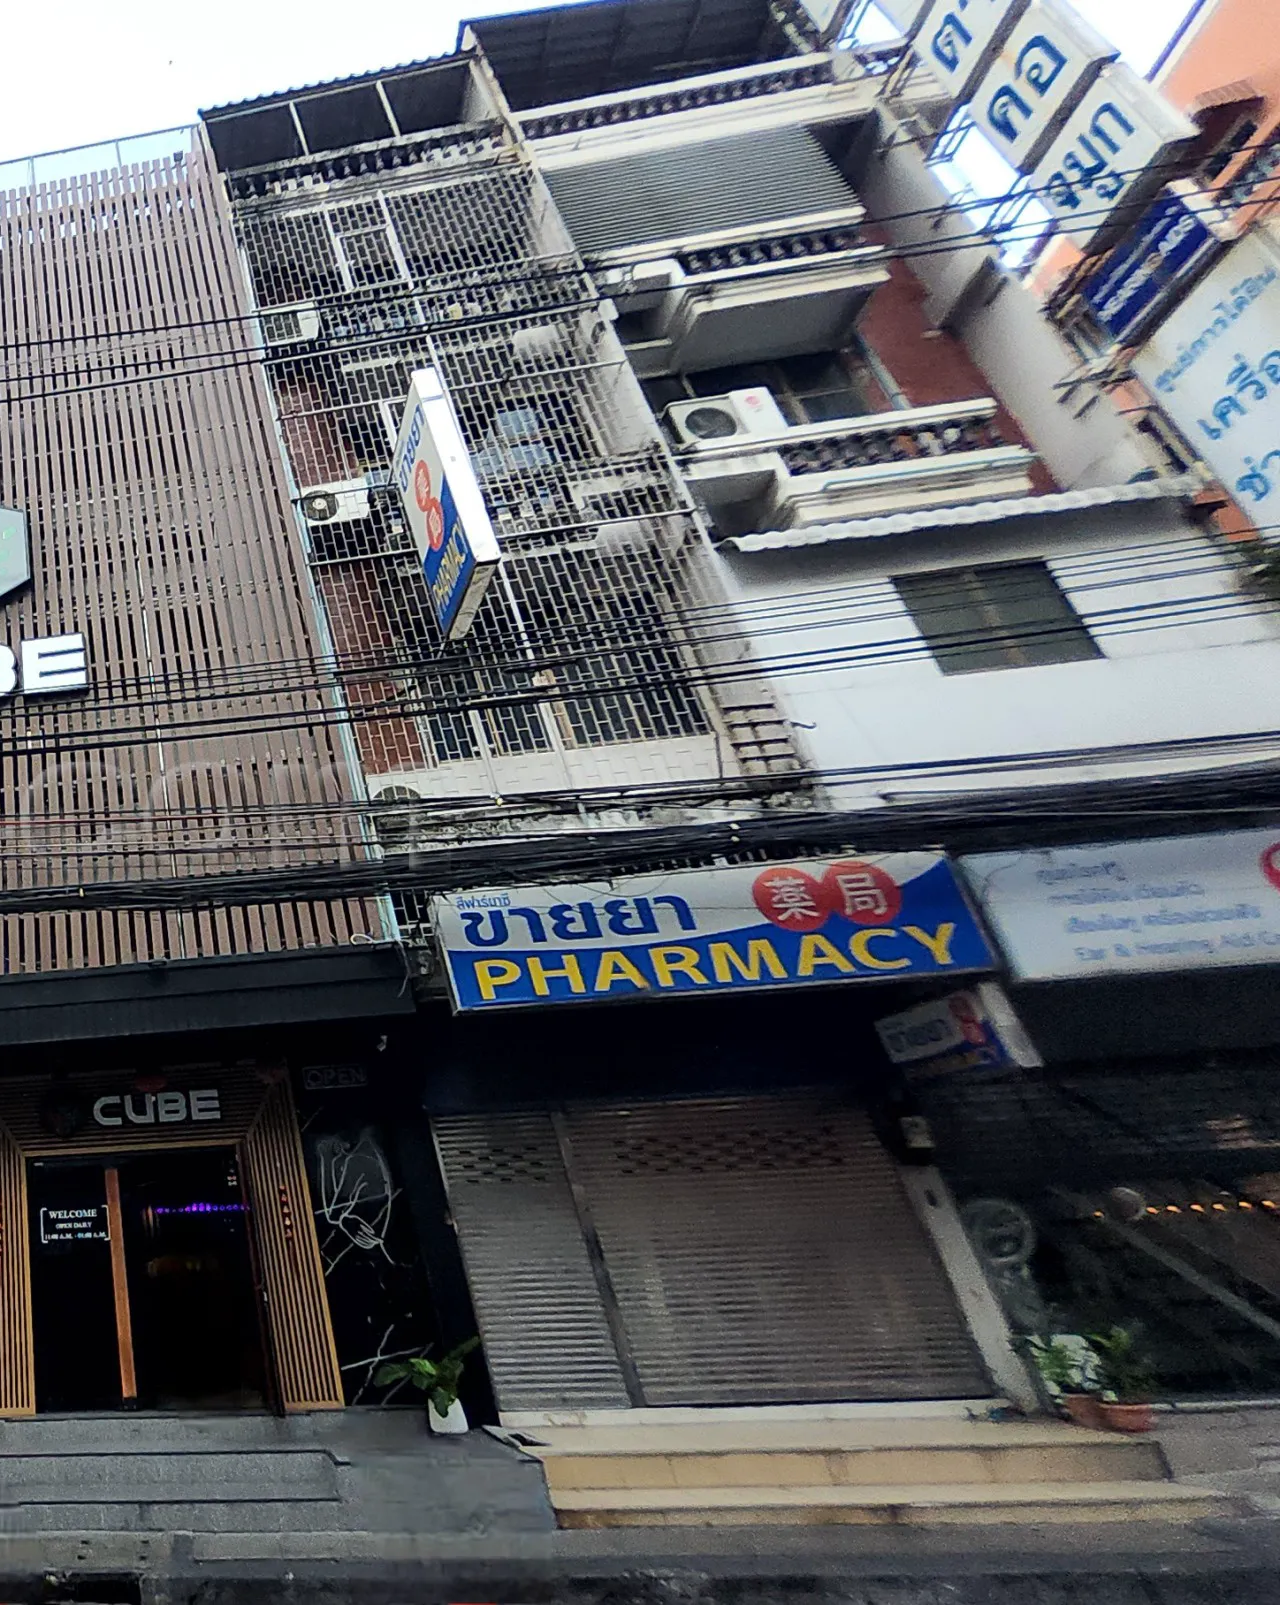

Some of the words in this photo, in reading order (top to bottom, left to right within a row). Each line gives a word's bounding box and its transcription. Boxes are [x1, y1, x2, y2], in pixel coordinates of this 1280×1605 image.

[987, 35, 1068, 144] คอ
[1046, 101, 1136, 210] จมูก
[460, 895, 697, 947] ขายยา
[473, 922, 955, 1001] PHARMACY
[307, 1068, 367, 1087] OPEN
[92, 1088, 221, 1127] CUBE
[48, 1208, 98, 1219] WELCOME
